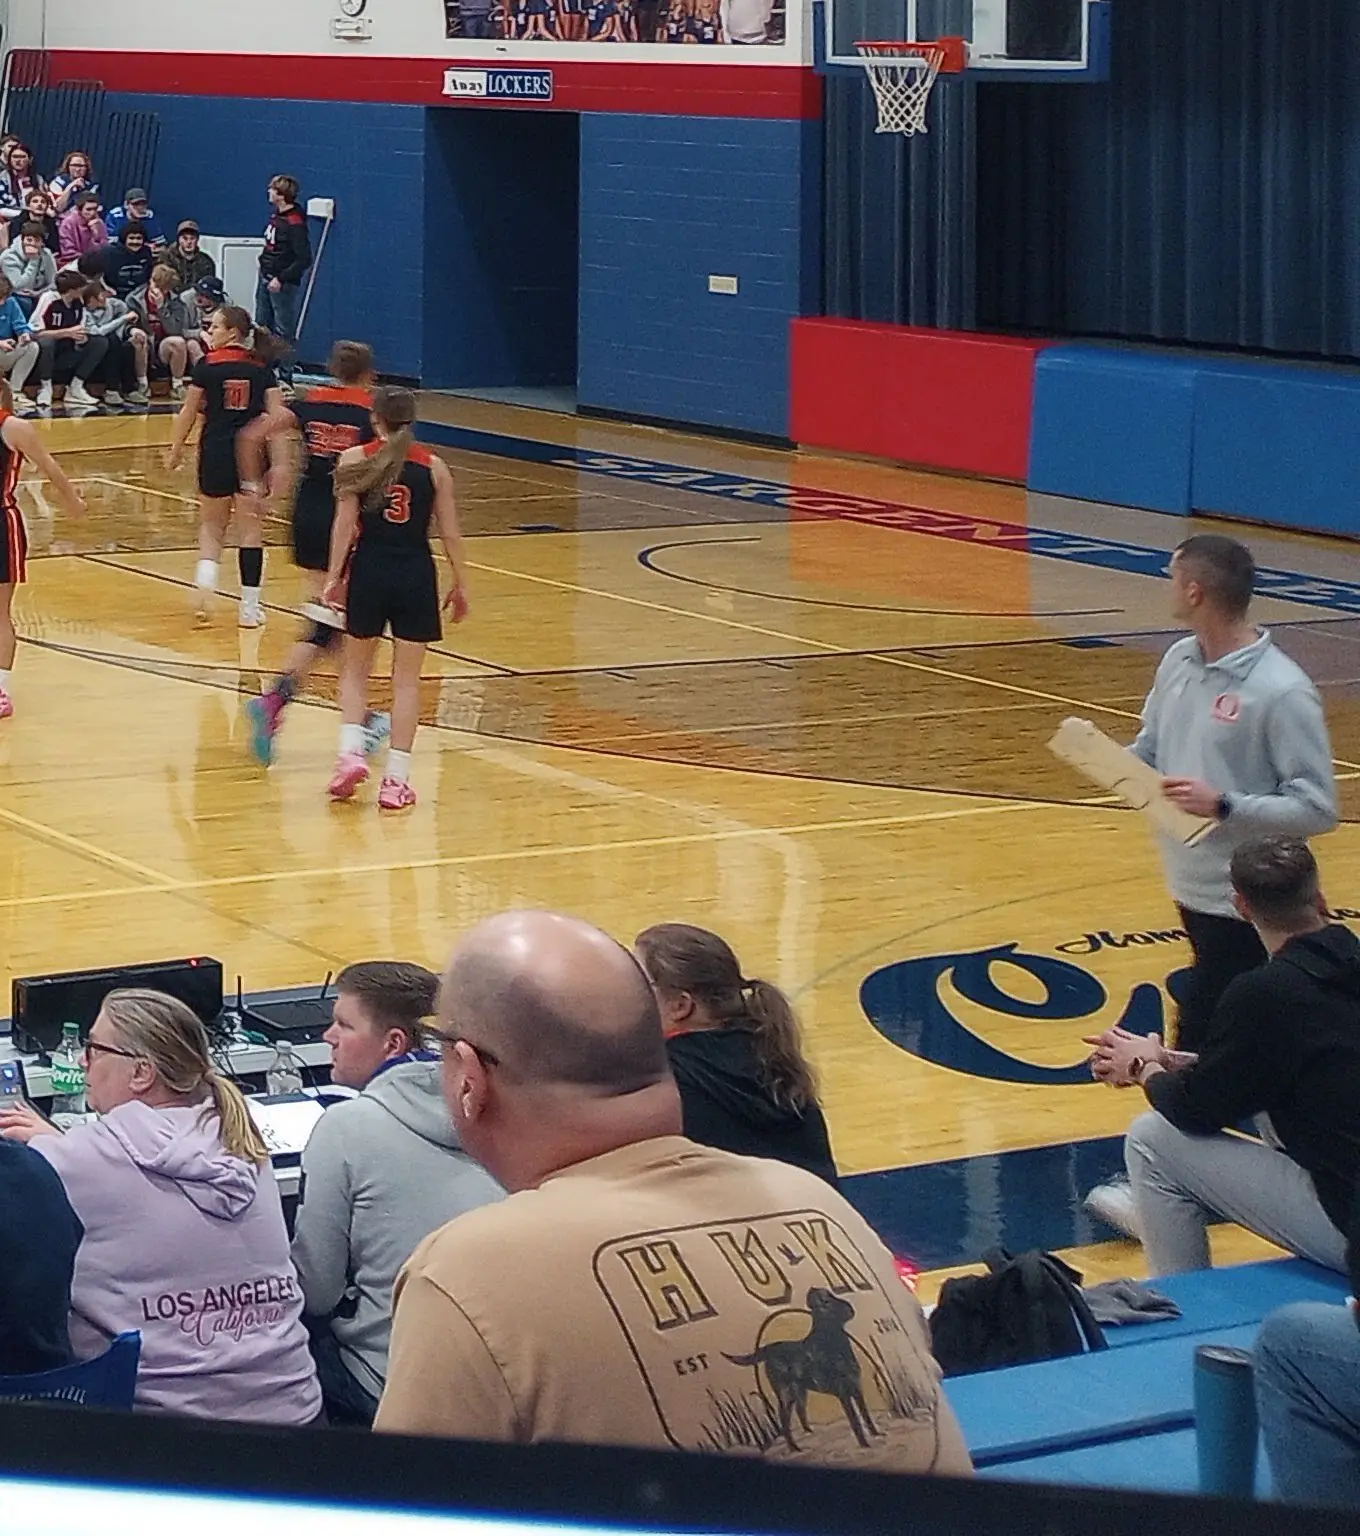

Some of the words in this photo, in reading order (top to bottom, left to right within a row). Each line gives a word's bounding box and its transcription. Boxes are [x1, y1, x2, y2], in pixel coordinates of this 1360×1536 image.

[488, 74, 550, 95] LOCKERS
[550, 456, 1159, 559] SARGENT
[1054, 928, 1190, 955] Hom
[140, 1292, 195, 1321] LOS
[202, 1275, 296, 1312] ANGELES
[673, 1352, 709, 1376] EST
